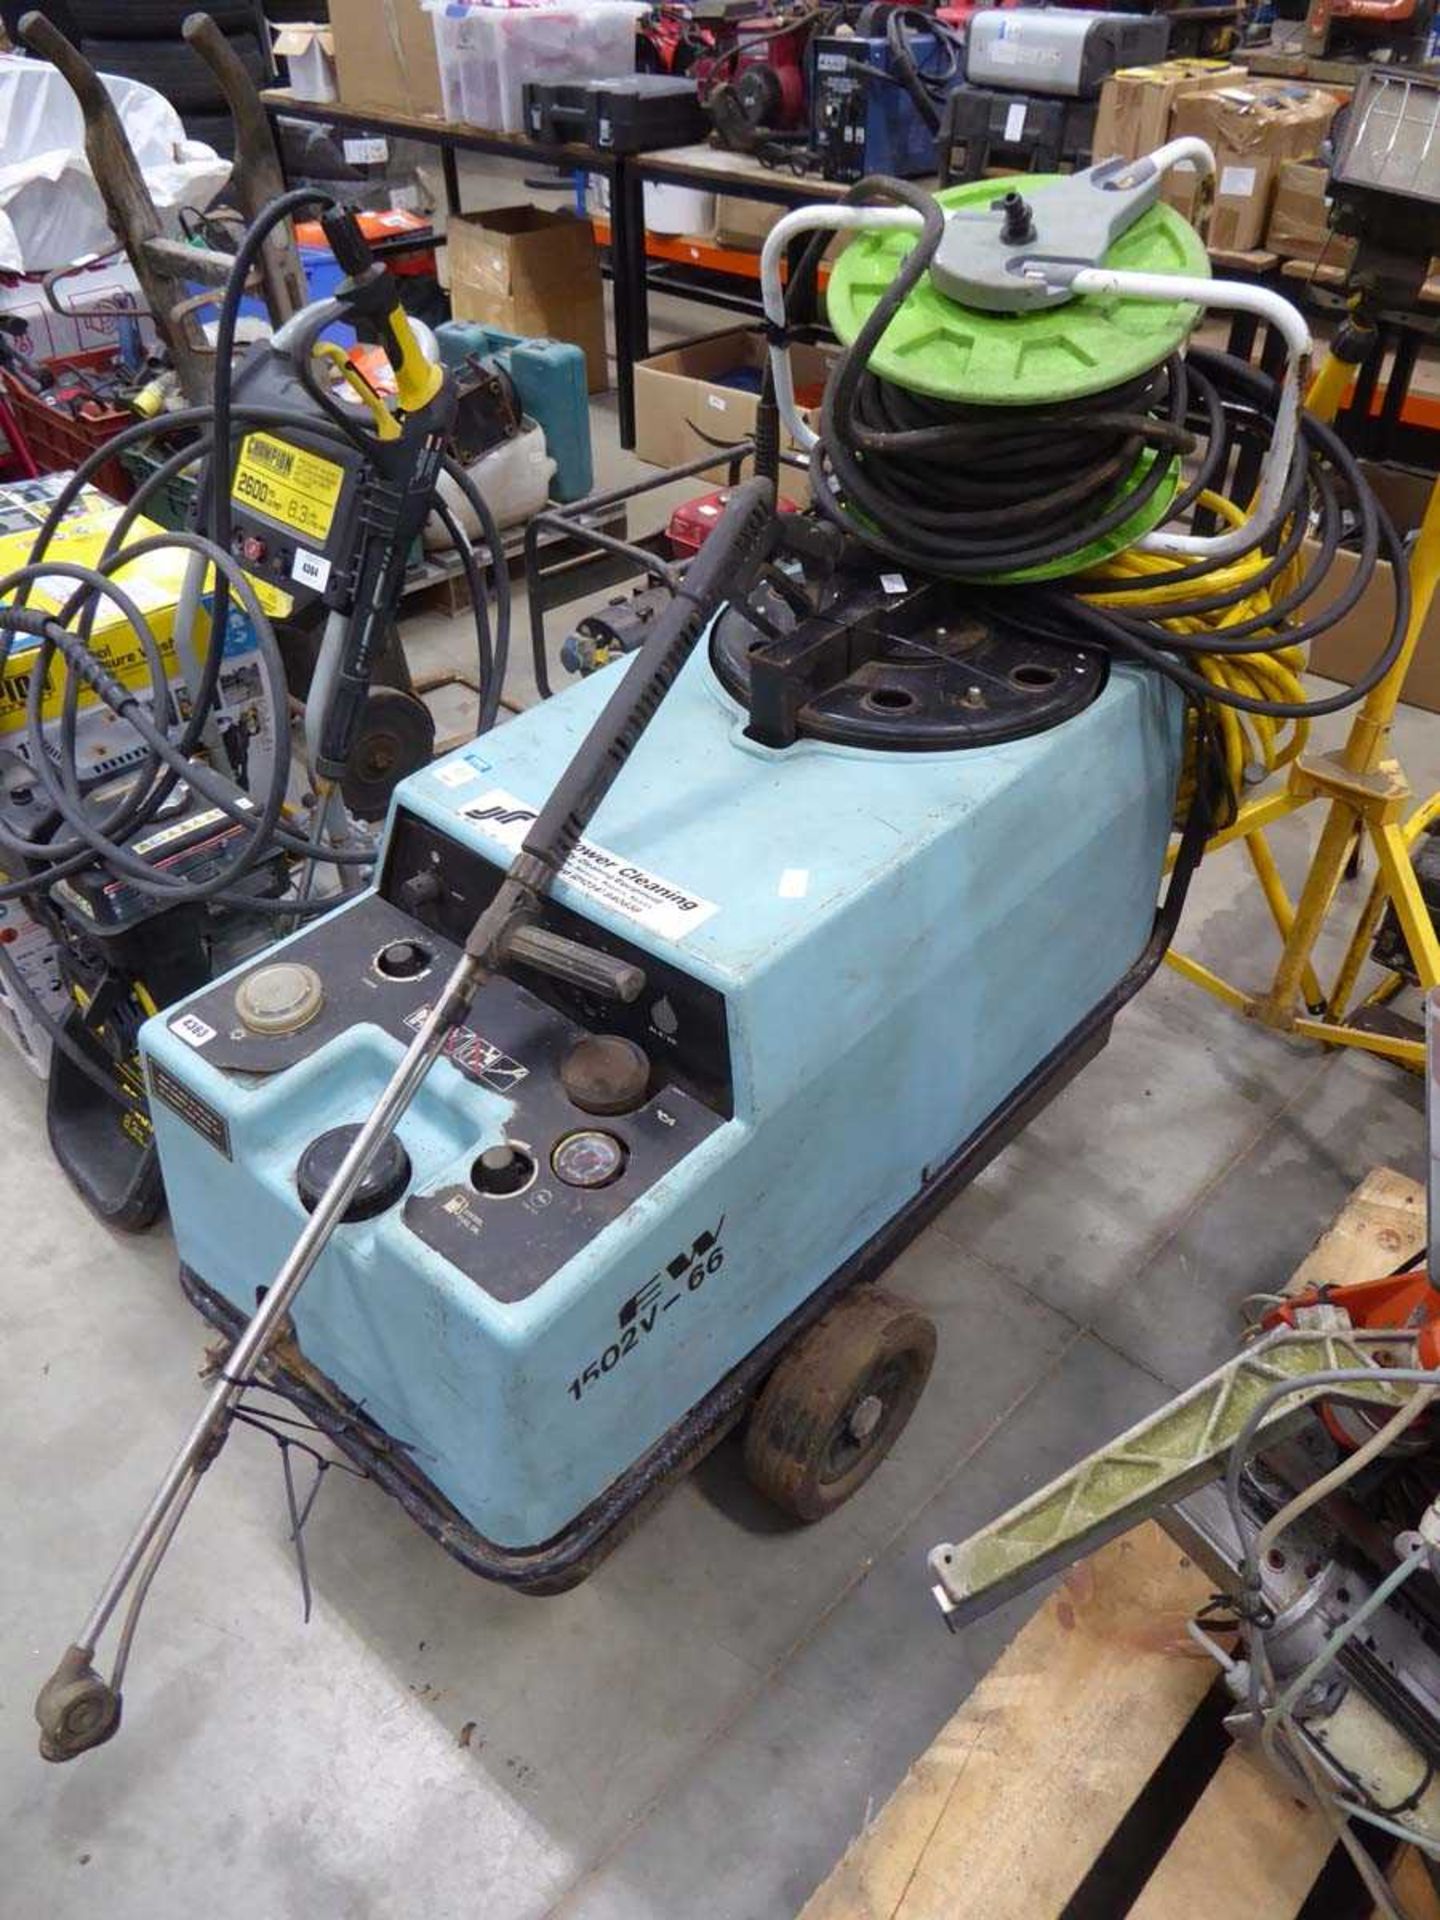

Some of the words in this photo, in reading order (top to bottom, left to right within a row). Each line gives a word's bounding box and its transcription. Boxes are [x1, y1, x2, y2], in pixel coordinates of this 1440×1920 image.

[237, 472, 269, 502] 2600
[618, 866, 699, 911] Cleaning
[182, 1018, 209, 1039] 4383
